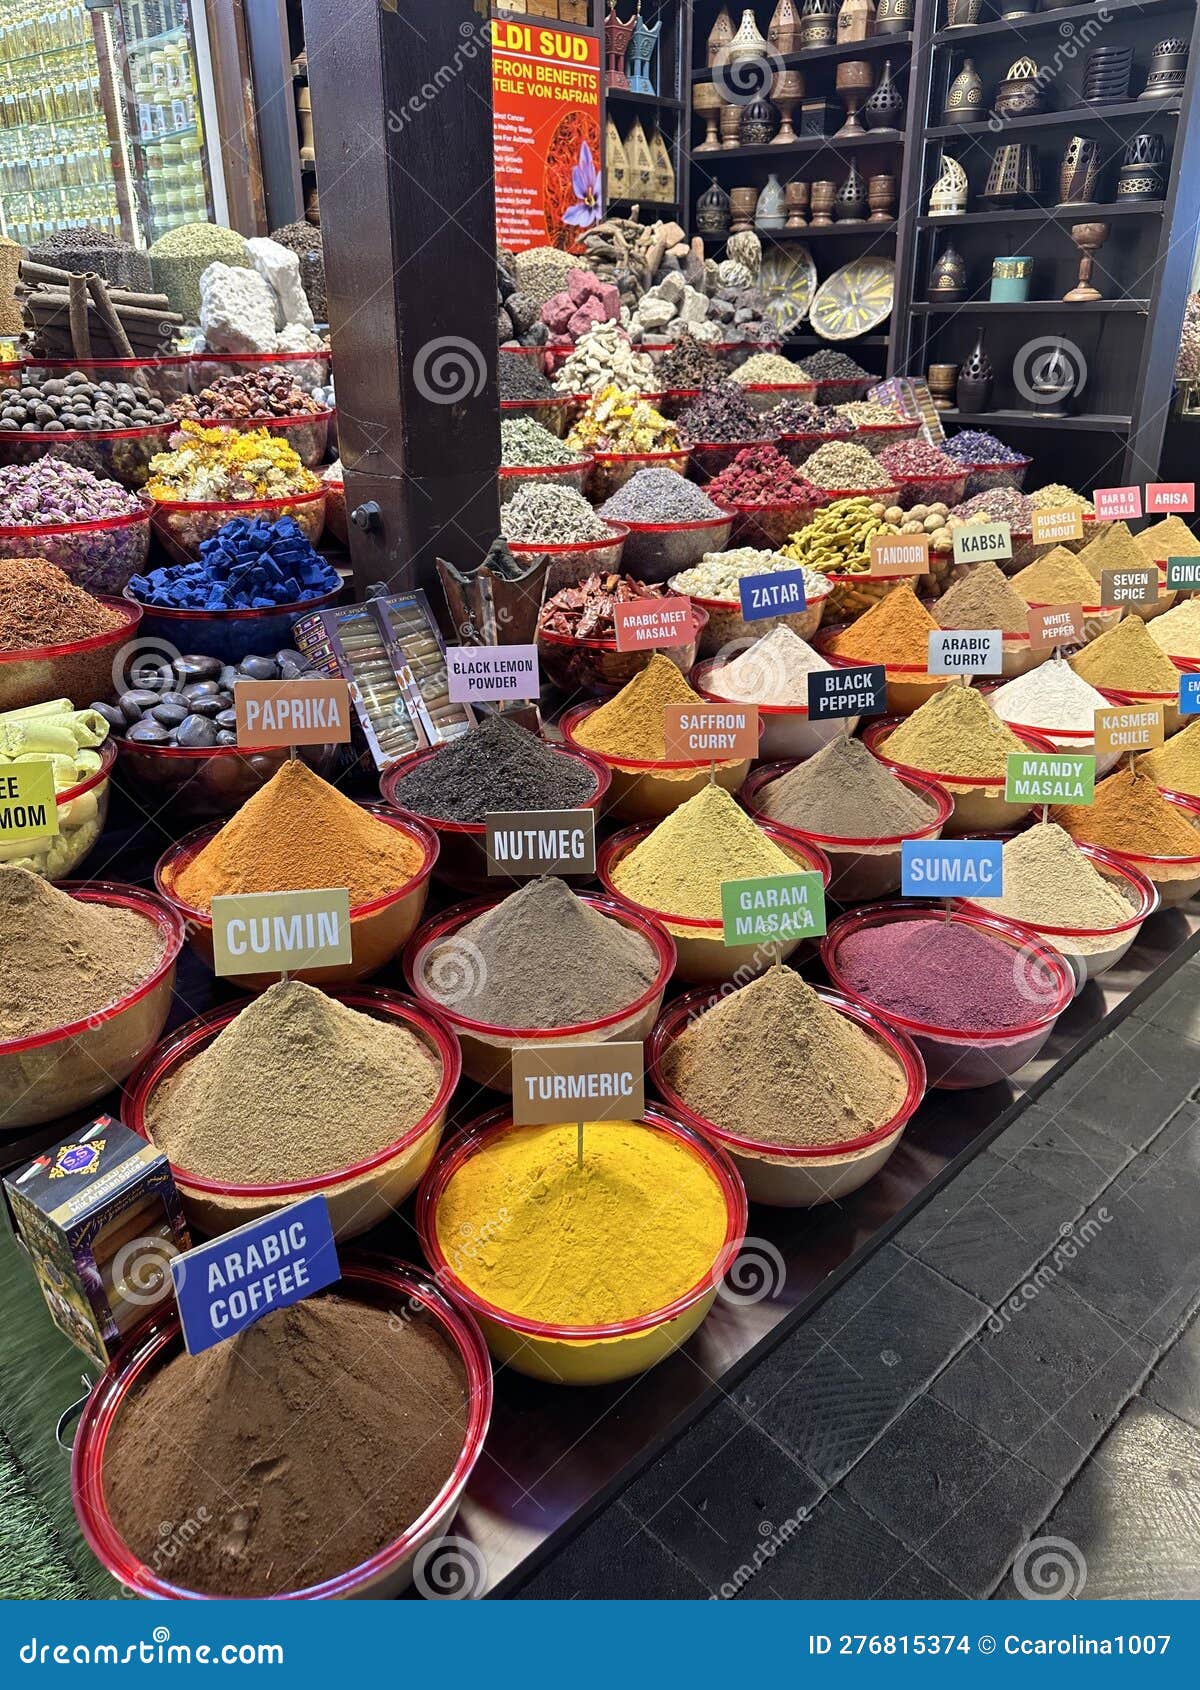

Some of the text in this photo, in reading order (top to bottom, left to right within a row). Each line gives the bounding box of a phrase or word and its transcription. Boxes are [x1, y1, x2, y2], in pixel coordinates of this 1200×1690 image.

[540, 31, 588, 61] SUD
[493, 58, 597, 89] FRON BENEFITS
[493, 77, 597, 105] TEILE VON SAFRAN
[1155, 493, 1188, 505] ARISA
[1100, 504, 1135, 516] MASALA
[1037, 512, 1076, 527] RUSSELL
[962, 534, 1005, 552] KABSA
[877, 547, 923, 564] TANDOORI
[1113, 573, 1148, 585] SEVEN
[751, 583, 799, 609] ZATAR
[1113, 588, 1145, 600] SPICE
[623, 610, 686, 628] ARABIC MEET
[1043, 612, 1071, 626] WHITE
[636, 626, 677, 641] MASALA
[1042, 625, 1075, 639] PEPPER
[942, 638, 990, 650] ARABIC
[453, 659, 533, 675] BLACK LEMON
[944, 654, 987, 666] CURRY
[468, 676, 518, 690] POWDER
[825, 673, 873, 692] BLACK
[819, 692, 875, 712] PEPPER
[246, 697, 341, 731] PAPRIKA
[680, 714, 746, 729] SAFFRON
[1102, 711, 1158, 729] KASMERI
[689, 734, 737, 749] CURRY
[1110, 730, 1150, 745] CHILIE
[1022, 761, 1083, 777] MANDY
[1015, 780, 1084, 797] MASALA
[494, 829, 585, 861] NUTMEG
[910, 858, 993, 882] SUMAC
[740, 886, 808, 911] GARAM
[735, 910, 815, 936] MASALA
[226, 911, 340, 956] CUMIN
[524, 1072, 633, 1100] TURMERIC
[208, 1221, 307, 1294] ARABIC
[209, 1257, 310, 1329] COFFEE
